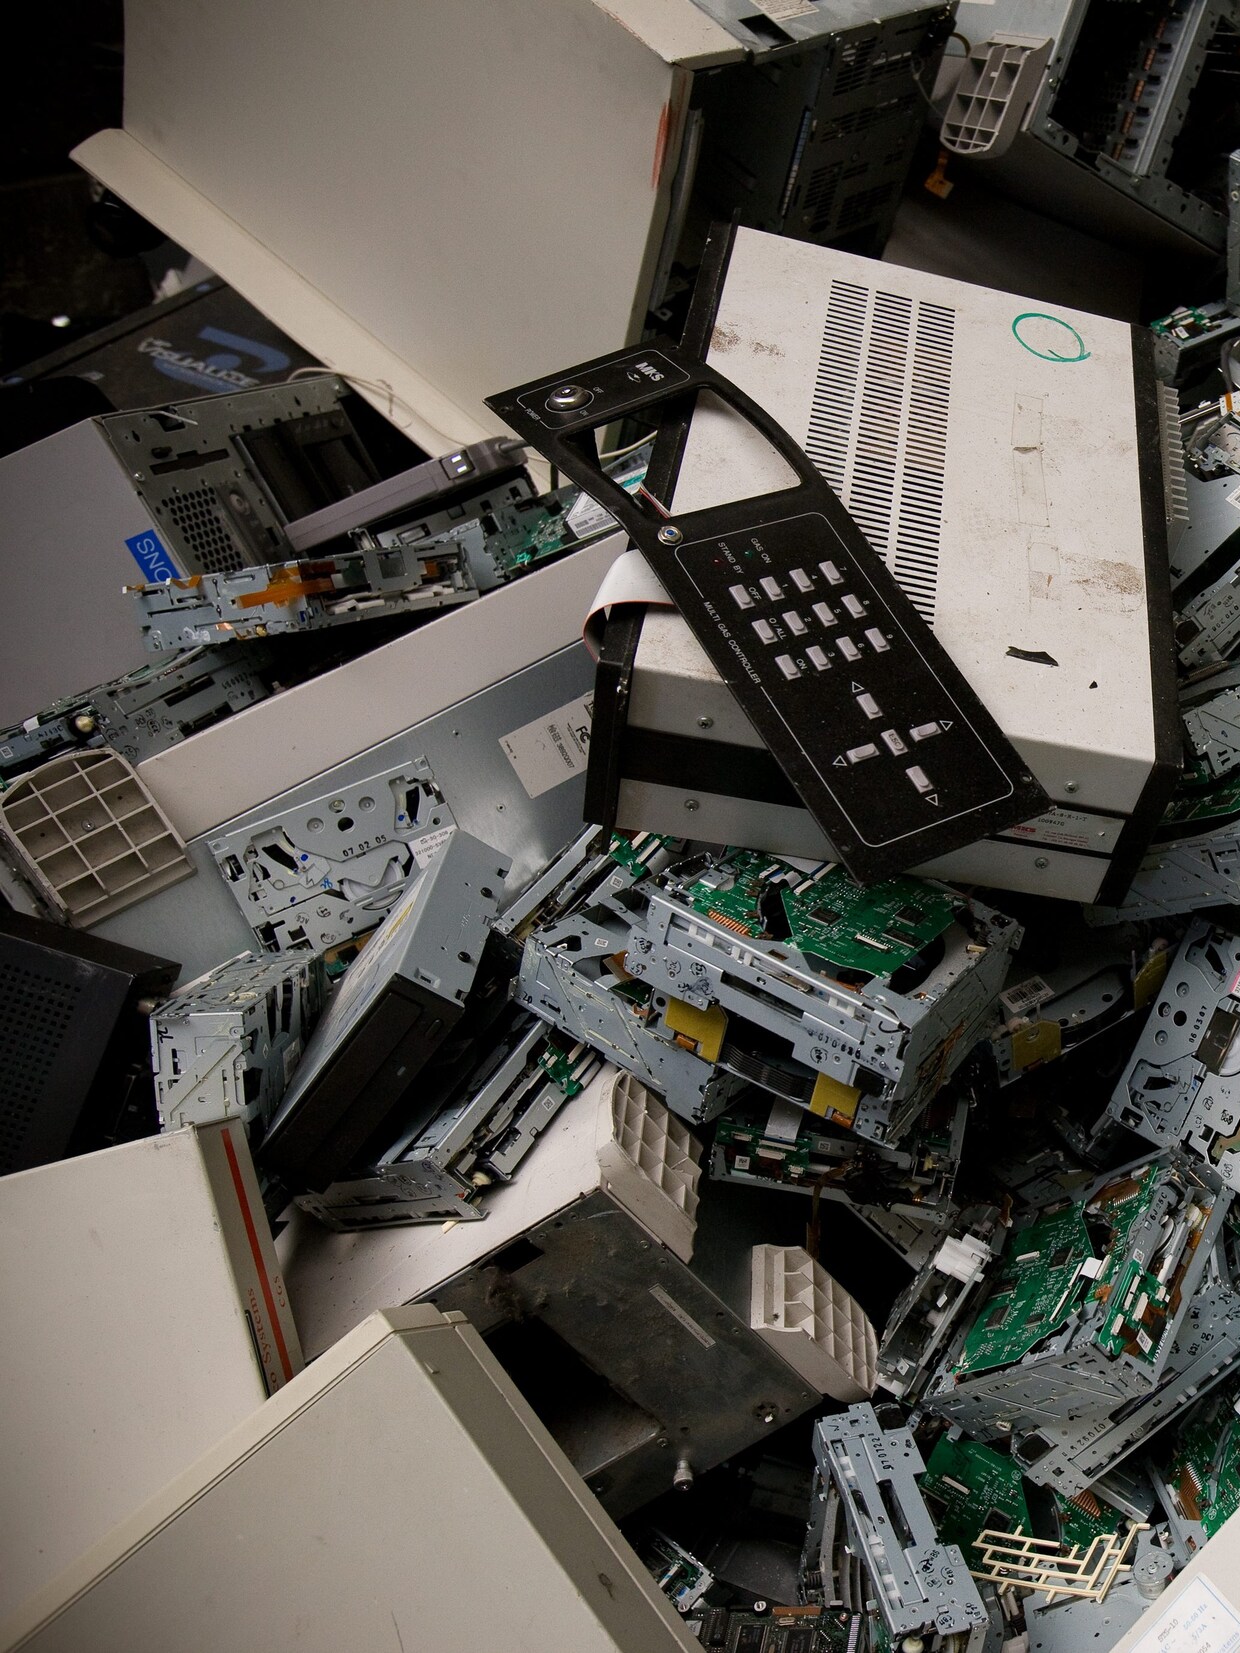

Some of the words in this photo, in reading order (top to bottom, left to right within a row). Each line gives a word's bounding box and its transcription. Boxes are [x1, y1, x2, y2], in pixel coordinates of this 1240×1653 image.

[635, 361, 665, 383] MKS
[524, 407, 542, 422] POWER
[717, 541, 736, 563] STAND
[733, 563, 745, 575] BY
[750, 537, 764, 552] GAS
[760, 552, 772, 564] ON
[748, 586, 762, 601] OFF
[703, 601, 721, 622] MULTI
[717, 622, 731, 638] GAS
[728, 639, 762, 684] CONTROLLER
[796, 658, 808, 670] ON
[342, 847, 354, 857] 07
[358, 840, 371, 851] 02
[374, 834, 387, 844] 05
[247, 1287, 272, 1365] Systems
